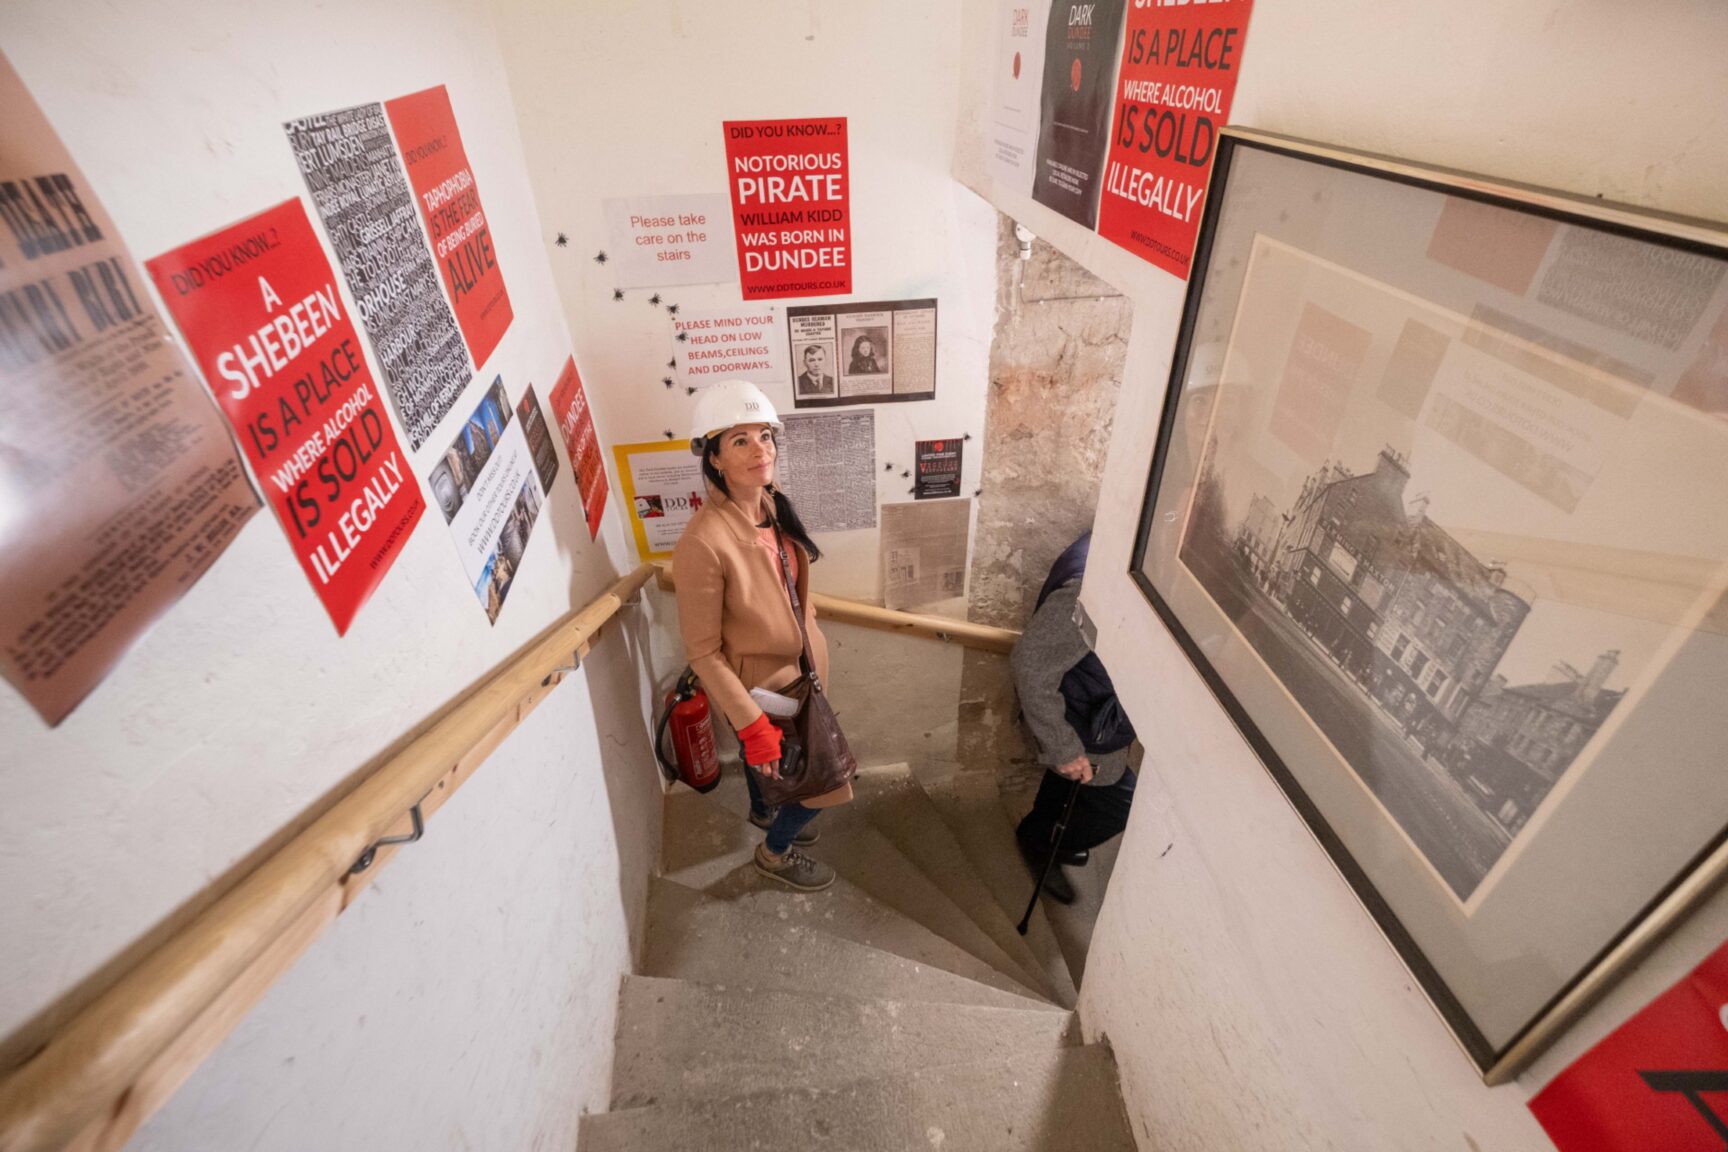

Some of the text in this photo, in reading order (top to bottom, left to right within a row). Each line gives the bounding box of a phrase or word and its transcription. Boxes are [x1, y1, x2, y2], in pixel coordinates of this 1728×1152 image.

[1068, 4, 1095, 26] DARK
[1128, 28, 1238, 70] IS A PLACE
[1123, 79, 1222, 114] WHERE ALCOHOL
[731, 123, 842, 140] DID YOU KNOW...?
[1117, 104, 1213, 167] IS SOLD
[316, 133, 366, 166] LUMSDEN
[735, 153, 841, 172] NOTORIOUS
[423, 168, 474, 212] TAPHOPHOBIA
[738, 174, 843, 205] PIRATE
[1106, 160, 1203, 223] ILLEGALLY
[358, 215, 392, 246] GRISSELL
[430, 213, 442, 240] IS
[441, 201, 461, 230] THE
[459, 188, 479, 218] FEAR
[630, 213, 706, 228] Please take
[740, 209, 843, 226] WILLIAM KIDD
[437, 241, 450, 259] OF
[447, 226, 467, 251] BEING
[464, 211, 485, 237] BURIED
[635, 231, 706, 245] care on the
[742, 229, 845, 246] WAS BORN IN
[360, 241, 405, 282] TOLBOOTH
[447, 229, 495, 304] ALIVE
[656, 249, 691, 262] stairs
[745, 247, 846, 272] DUNDEE
[171, 269, 204, 296] DID
[201, 254, 232, 282] YOU
[748, 281, 846, 294] WWW.DDTOURS.CO.UK
[258, 276, 282, 312] A
[357, 272, 408, 321] ORHOUSE
[675, 315, 774, 330] PLEASE MIND YOUR
[690, 331, 762, 345] HEAD ON LOW
[217, 284, 341, 399] SHEBEEN
[378, 322, 418, 370] HARBOUR
[688, 346, 769, 361] BEAMS,CEILINGS
[688, 361, 773, 375] AND DOORWAYS.
[247, 339, 361, 458] IS A PLACE
[745, 402, 760, 411] DD
[271, 431, 327, 493] WHERE
[323, 384, 373, 446] ALCOHOL
[287, 408, 383, 539] IS SOLD
[310, 452, 404, 584] ILLEGALLY
[665, 497, 688, 509] DD
